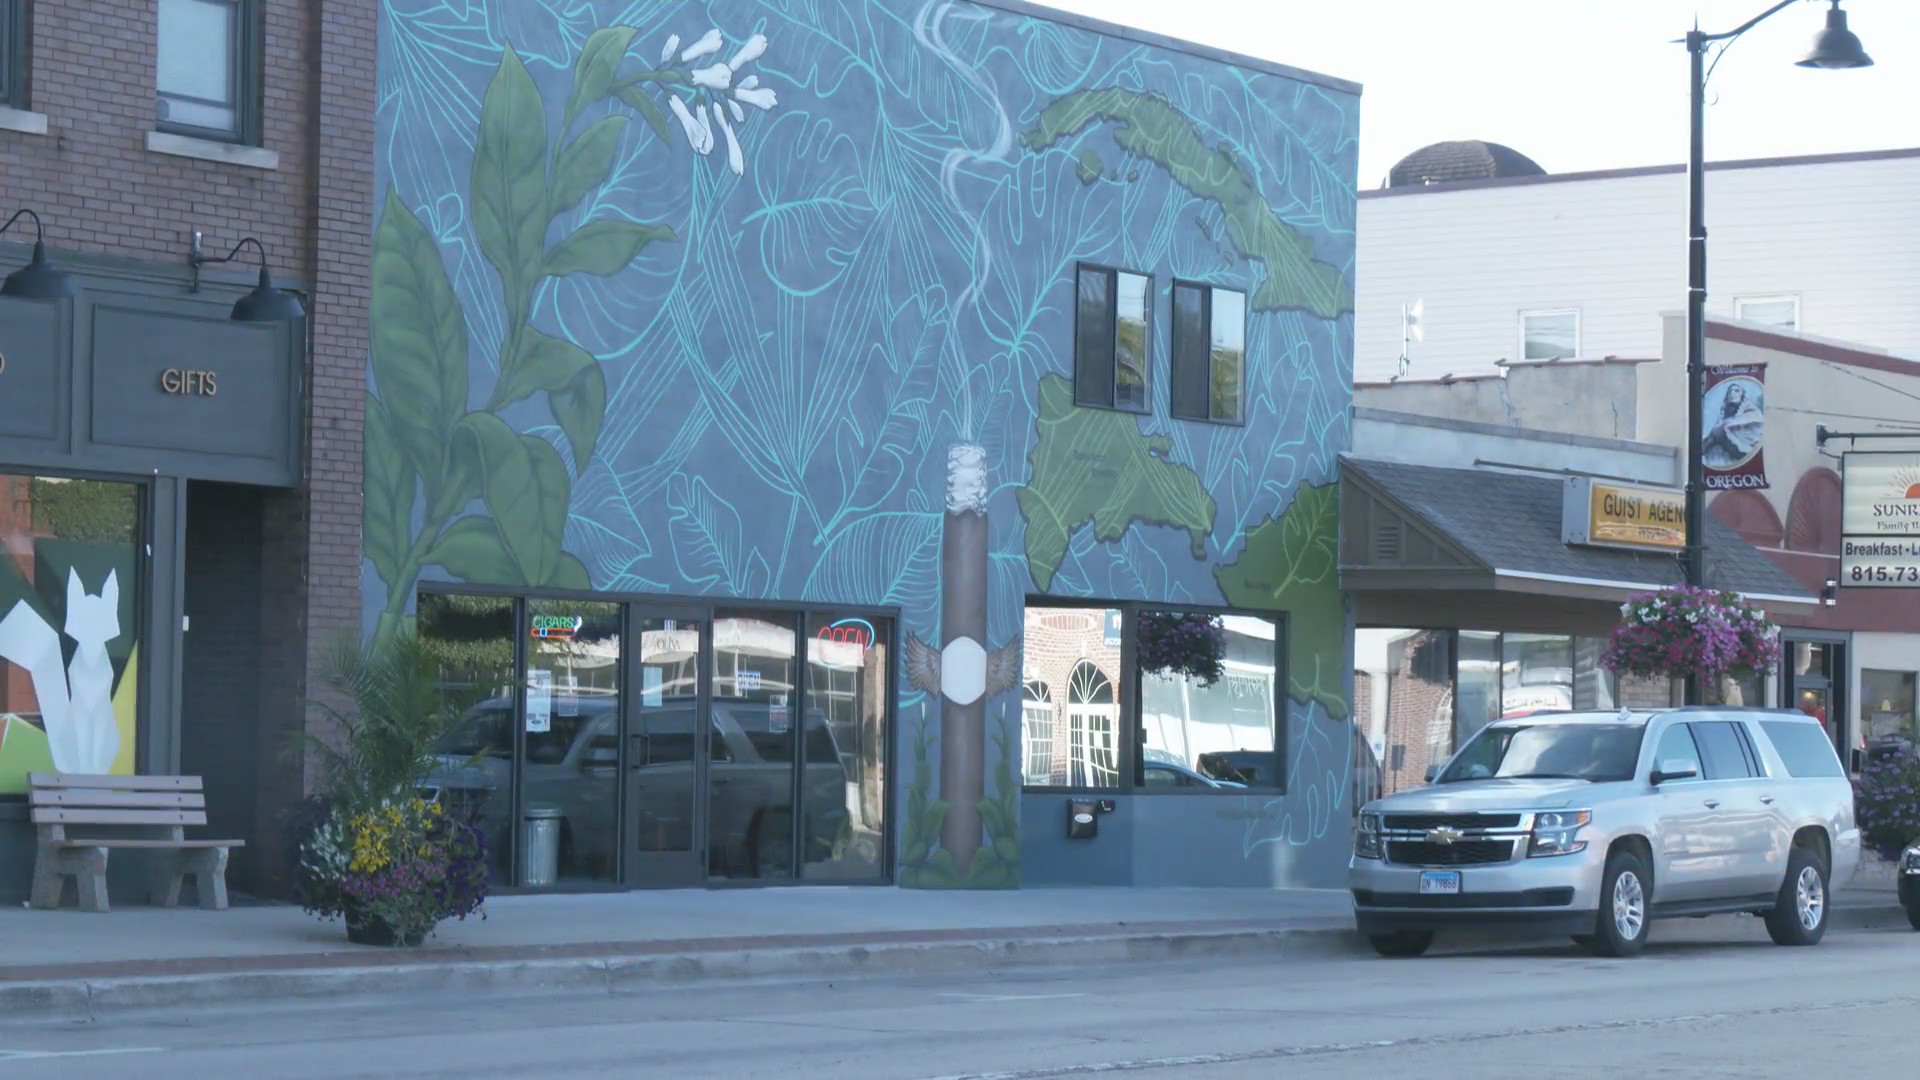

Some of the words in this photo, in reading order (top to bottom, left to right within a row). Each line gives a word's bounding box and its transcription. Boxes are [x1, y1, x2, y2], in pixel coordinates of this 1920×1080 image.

[162, 368, 217, 396] GIFTS
[1706, 473, 1765, 489] OREGON
[1603, 494, 1641, 519] GUIST
[1648, 500, 1686, 524] AGEN
[1873, 503, 1920, 516] SUNR
[1845, 541, 1903, 556] Breakfast
[1851, 565, 1920, 582] 815.73
[532, 614, 575, 629] CIGARS
[817, 626, 871, 657] OPEN
